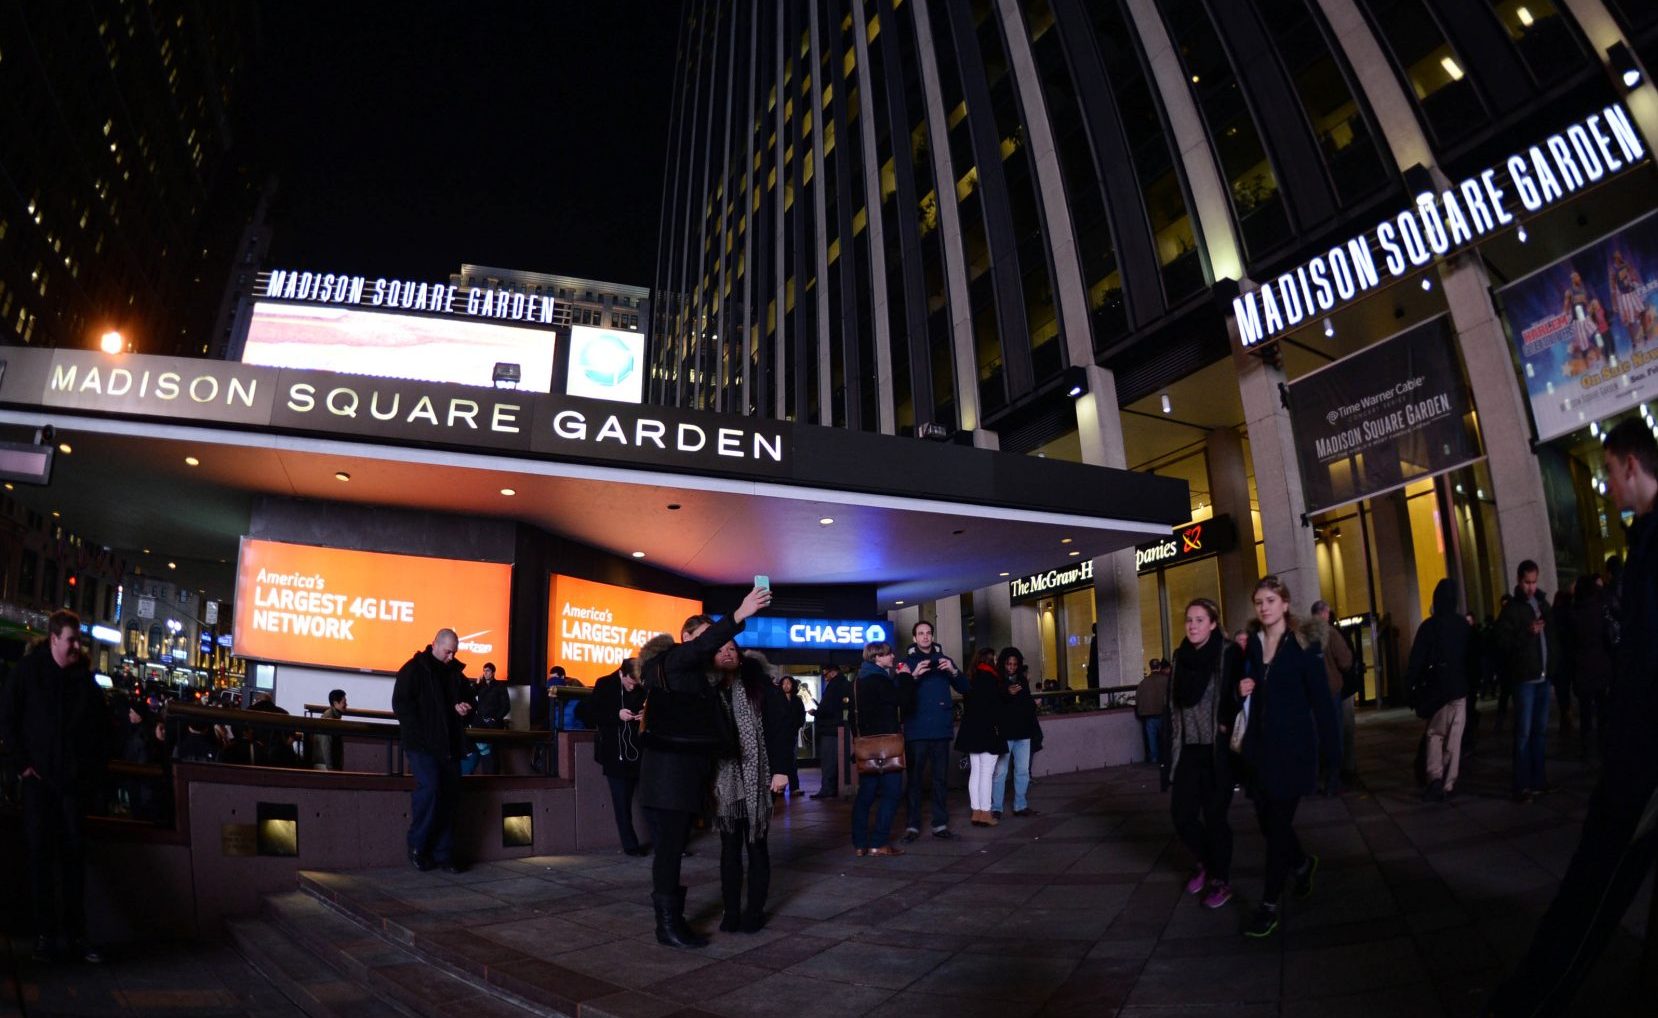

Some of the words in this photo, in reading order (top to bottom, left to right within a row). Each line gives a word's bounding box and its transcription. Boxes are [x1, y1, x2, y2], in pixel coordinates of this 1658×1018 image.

[1232, 235, 1380, 347] MADISON
[1376, 168, 1514, 277] SQUARE
[1507, 102, 1645, 212] GARDEN
[266, 269, 364, 304] MADISON
[372, 278, 458, 314] SQUARE
[467, 286, 556, 325] GARDEN
[50, 364, 258, 408] MADISON
[286, 383, 521, 434] SQUARE
[552, 409, 782, 462] GARDEN
[1338, 401, 1361, 419] Time
[1360, 387, 1395, 409] Warner
[1315, 427, 1363, 460] MADISON
[1362, 410, 1406, 441] SQUARE
[1405, 393, 1451, 426] GARDEN
[256, 568, 325, 590] America's
[1010, 578, 1030, 597] The
[254, 586, 348, 616] LARGEST
[348, 597, 377, 619] 4G
[379, 599, 414, 622] LTE
[562, 601, 613, 623] America's
[252, 610, 354, 641] NETWORK
[561, 618, 628, 645] LARGEST
[790, 624, 864, 644] CHASE
[457, 640, 493, 654] erizon
